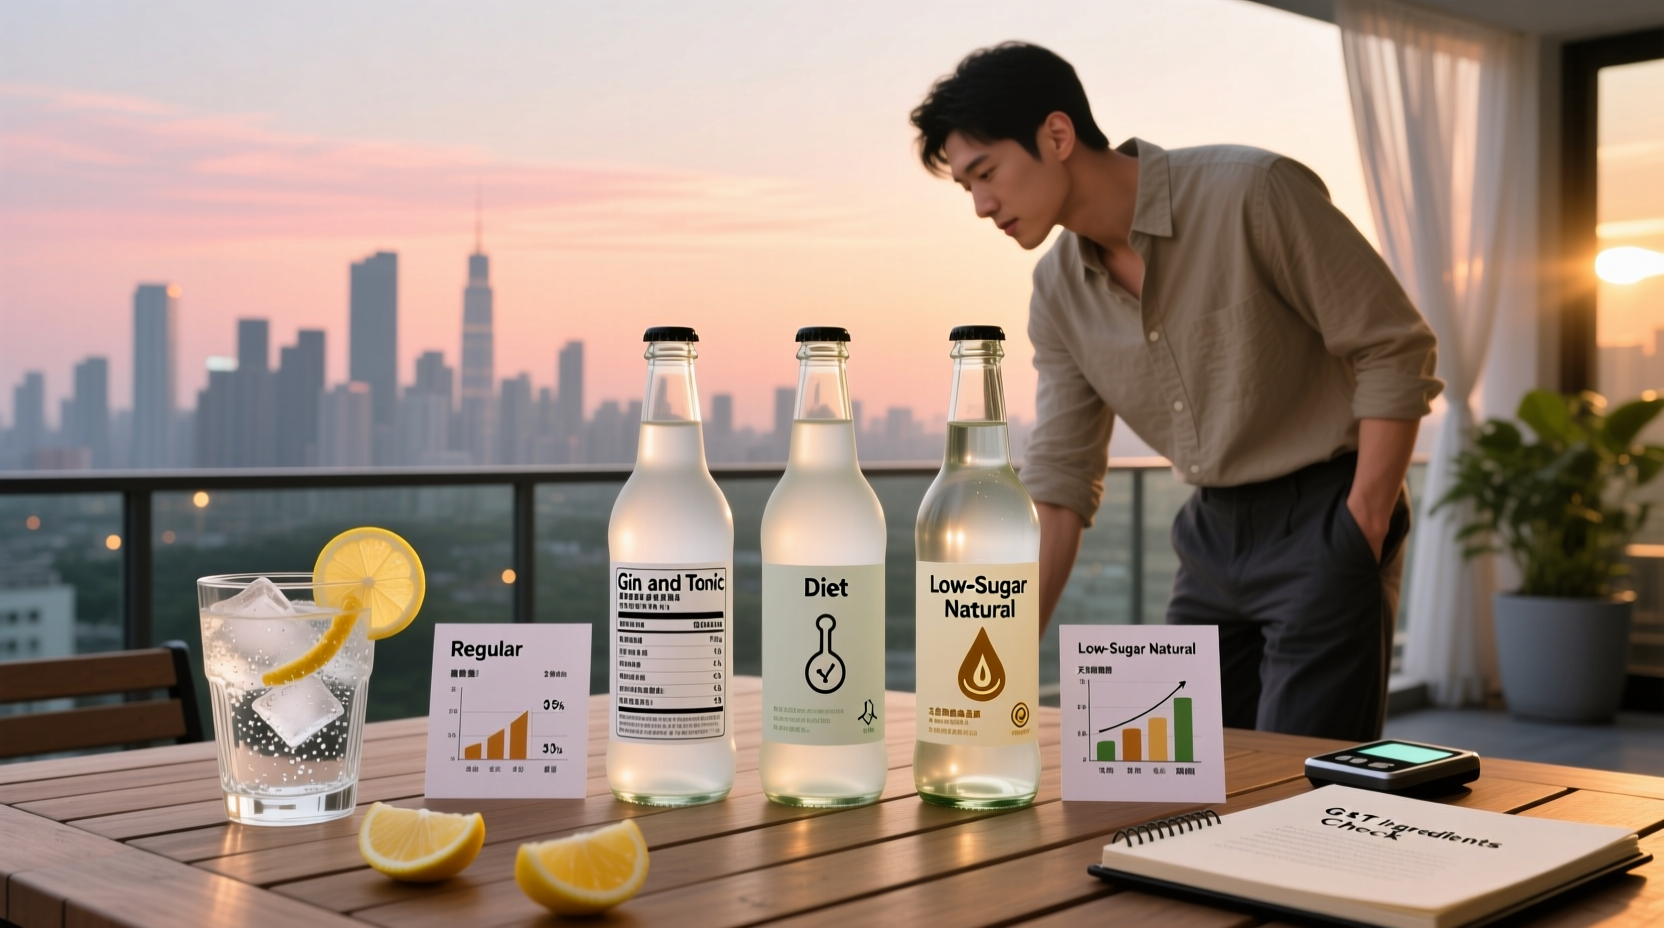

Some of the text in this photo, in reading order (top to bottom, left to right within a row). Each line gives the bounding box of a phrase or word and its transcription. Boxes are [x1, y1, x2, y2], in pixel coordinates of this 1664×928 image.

[618, 573, 725, 592] Gin and Tonic
[804, 577, 849, 597] Diet
[930, 575, 1028, 599] Low-Sugar
[945, 599, 1015, 618] Natural
[451, 640, 523, 661] Regular
[1078, 642, 1196, 657] Low-Sugar Natural
[1321, 818, 1403, 841] Check
